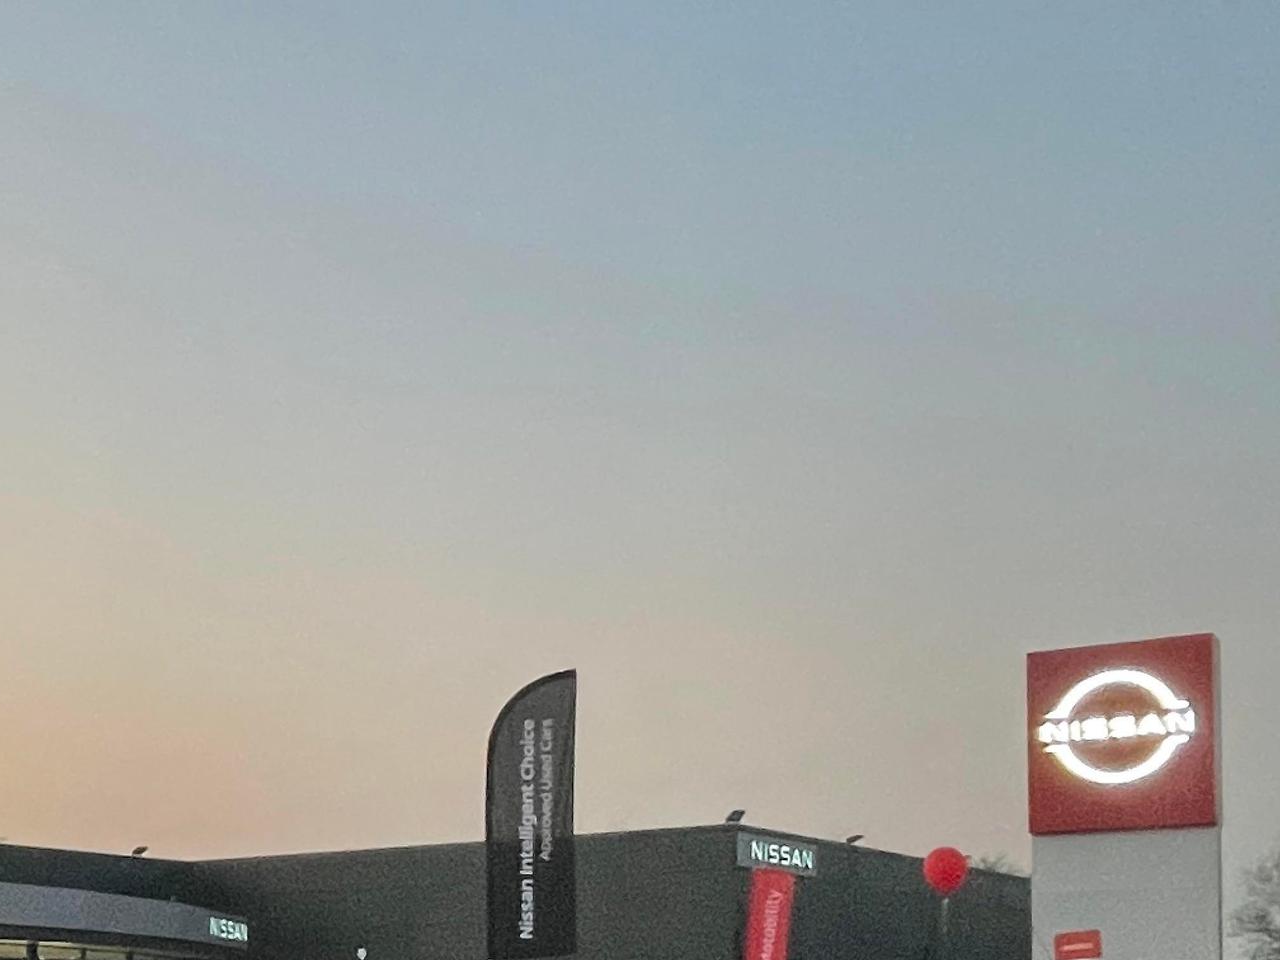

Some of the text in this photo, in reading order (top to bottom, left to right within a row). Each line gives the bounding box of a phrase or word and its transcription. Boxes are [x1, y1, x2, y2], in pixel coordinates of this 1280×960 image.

[1038, 707, 1196, 743] NISSAN
[540, 754, 553, 790] Used
[518, 718, 537, 940] Nissan Intelligent Choice
[539, 792, 553, 862] Approved
[750, 840, 813, 869] NISSAN
[210, 916, 248, 942] NISSAN
